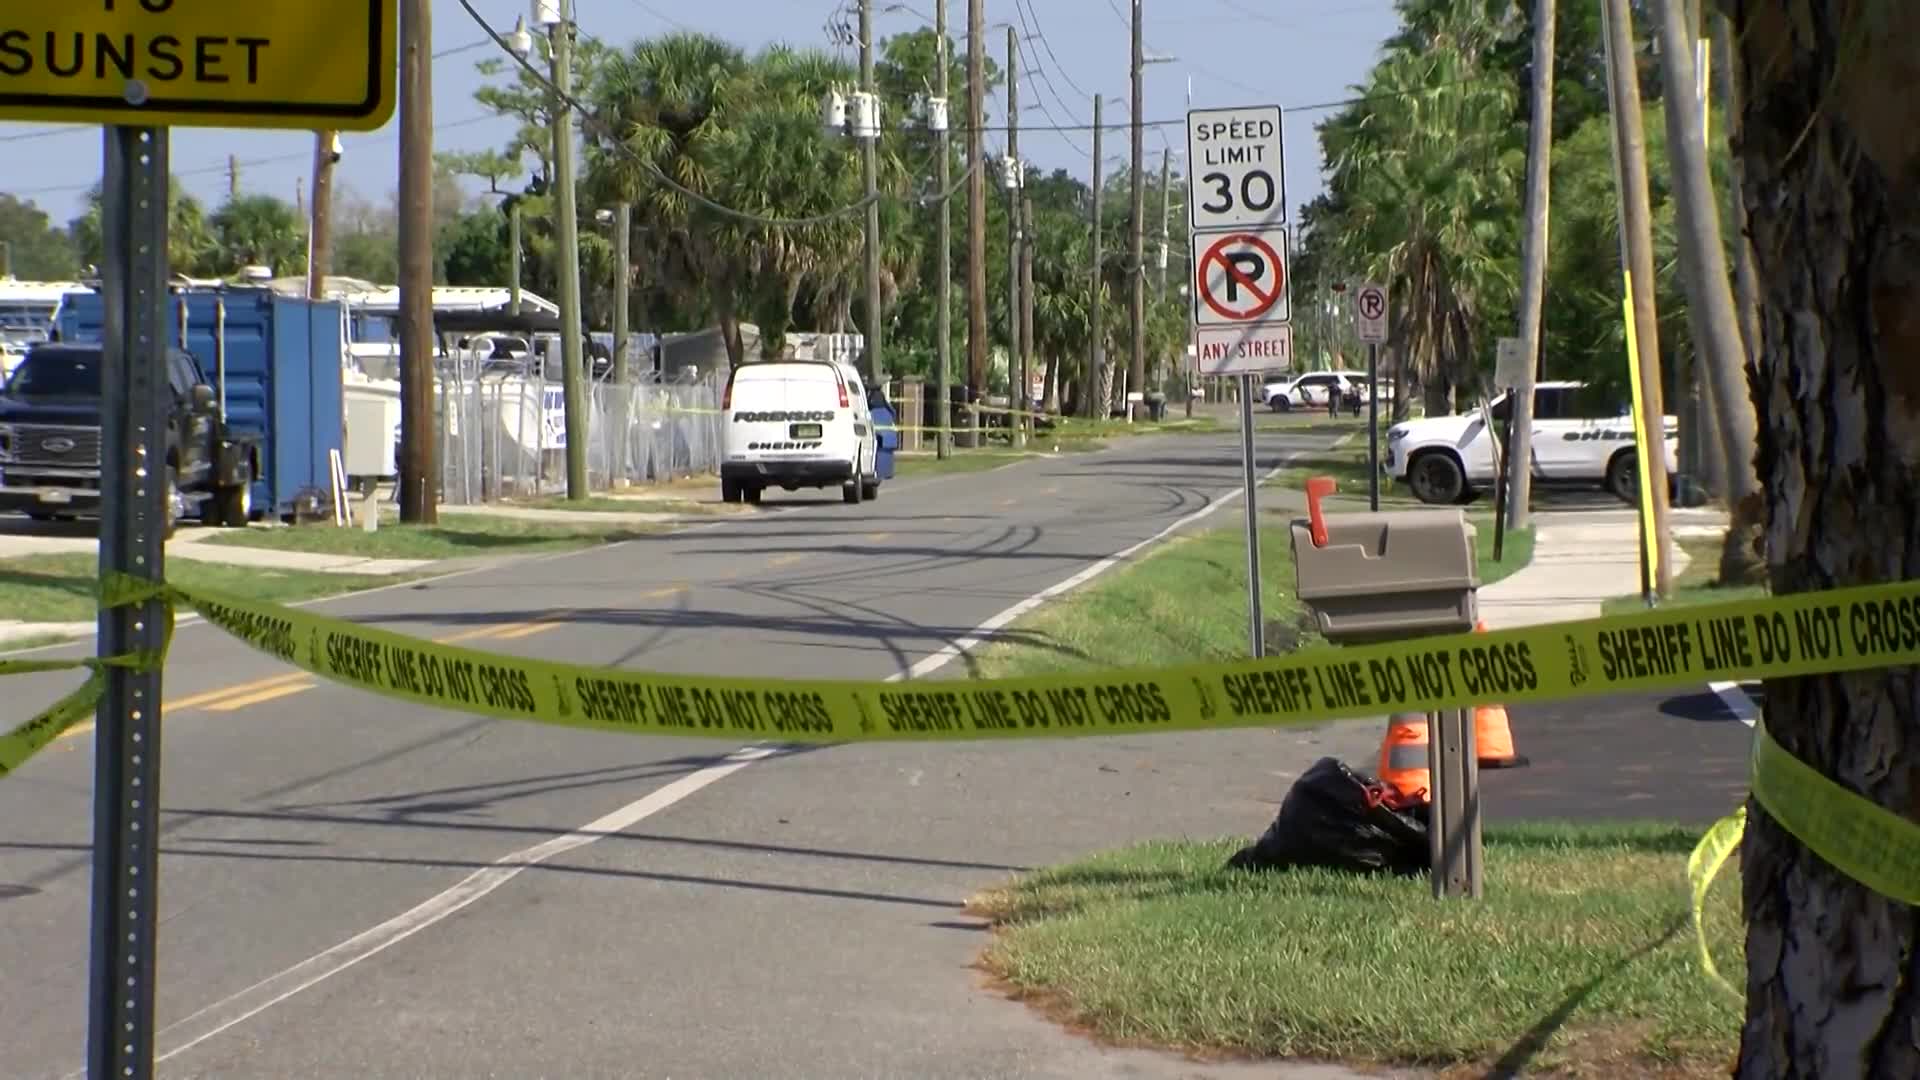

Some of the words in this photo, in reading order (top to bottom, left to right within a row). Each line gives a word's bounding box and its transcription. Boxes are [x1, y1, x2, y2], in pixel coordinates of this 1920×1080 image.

[0, 30, 270, 84] SUNSET
[1197, 120, 1273, 141] SPEED
[1205, 145, 1265, 165] LIMIT
[1202, 170, 1275, 214] 30
[1203, 342, 1230, 360] ANY
[1239, 339, 1286, 358] STREET
[733, 410, 835, 422] FORENSICS
[1597, 622, 1692, 682] SHERIFF
[1696, 616, 1752, 671] LINE
[1755, 611, 1792, 664] DO
[1795, 605, 1844, 661] NOT
[327, 633, 383, 686] SHERIFF
[384, 646, 420, 693] LINE
[420, 653, 444, 697] DO
[444, 658, 479, 704] NOT
[479, 664, 536, 713] CROSS
[1223, 665, 1313, 716] SHERIFF
[1314, 660, 1372, 708] LINE
[1368, 656, 1406, 704] DO
[1406, 650, 1457, 700] NOT
[1459, 640, 1538, 696] CROSS
[576, 677, 647, 724] SHERIFF
[648, 684, 695, 728] LINE
[692, 688, 725, 729] DO
[721, 688, 766, 731] NOT
[764, 691, 833, 733] CROSS
[880, 692, 963, 731] SHERIFF
[962, 691, 1018, 729] LINE
[1012, 689, 1050, 728] DO
[1047, 687, 1096, 727] NOT
[1095, 682, 1171, 724] CROSS
